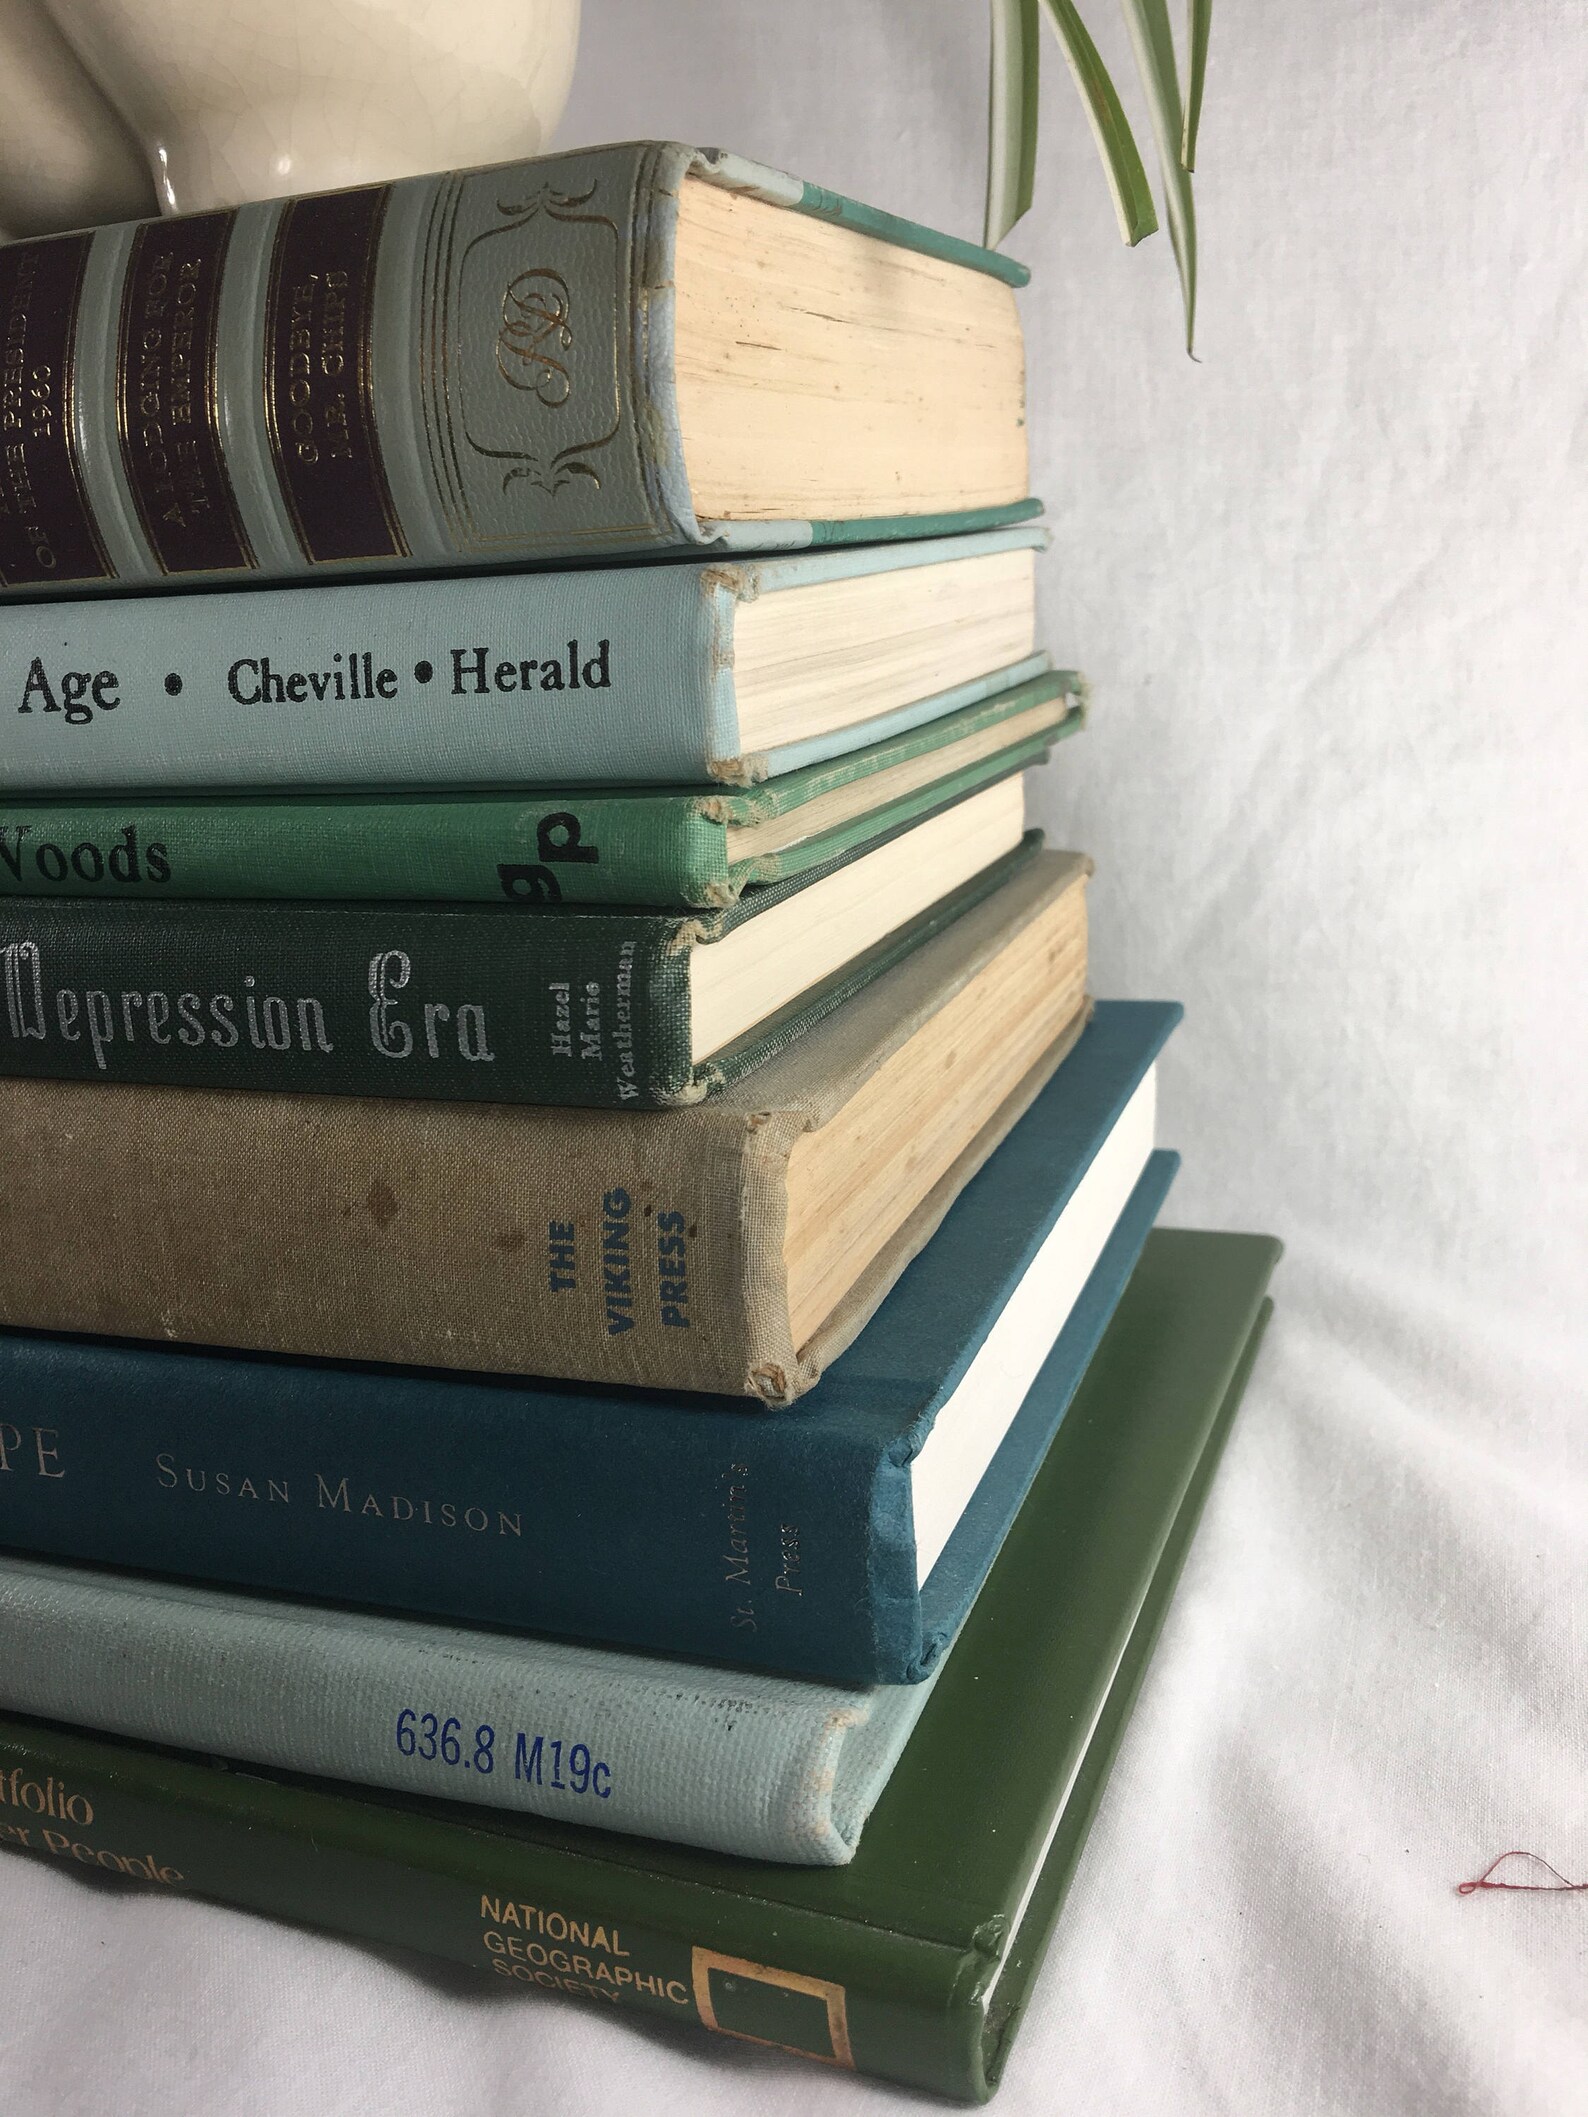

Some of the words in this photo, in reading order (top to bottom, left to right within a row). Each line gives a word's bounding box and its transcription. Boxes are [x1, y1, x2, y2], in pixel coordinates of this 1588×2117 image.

[170, 257, 202, 425] EMPEROR
[31, 364, 52, 438] 1960
[6, 443, 37, 514] THE
[26, 525, 57, 570] OF
[18, 656, 121, 725] Age
[227, 651, 399, 705] Cheville
[449, 638, 612, 695] Herald
[0, 940, 333, 1069] Depression
[367, 949, 496, 1063] Era
[549, 982, 572, 1058] Hazel
[580, 981, 603, 1061] Marie
[612, 940, 640, 1101] Weatherman
[549, 1220, 576, 1292] THE
[603, 1187, 635, 1335] VIKING
[658, 1211, 691, 1328] PRESS
[155, 1452, 290, 1503] SUSAN
[314, 1473, 523, 1537] MADISON
[721, 1463, 751, 1585] Martin's
[775, 1523, 803, 1597] Press
[396, 1708, 495, 1775] 636.8
[515, 1732, 612, 1799] M19c
[42, 1828, 185, 1888] People
[480, 1894, 630, 1957] NATIONAL
[483, 1931, 689, 2005] GEOGRAPHIC
[492, 1958, 620, 2002] SOCIETY
